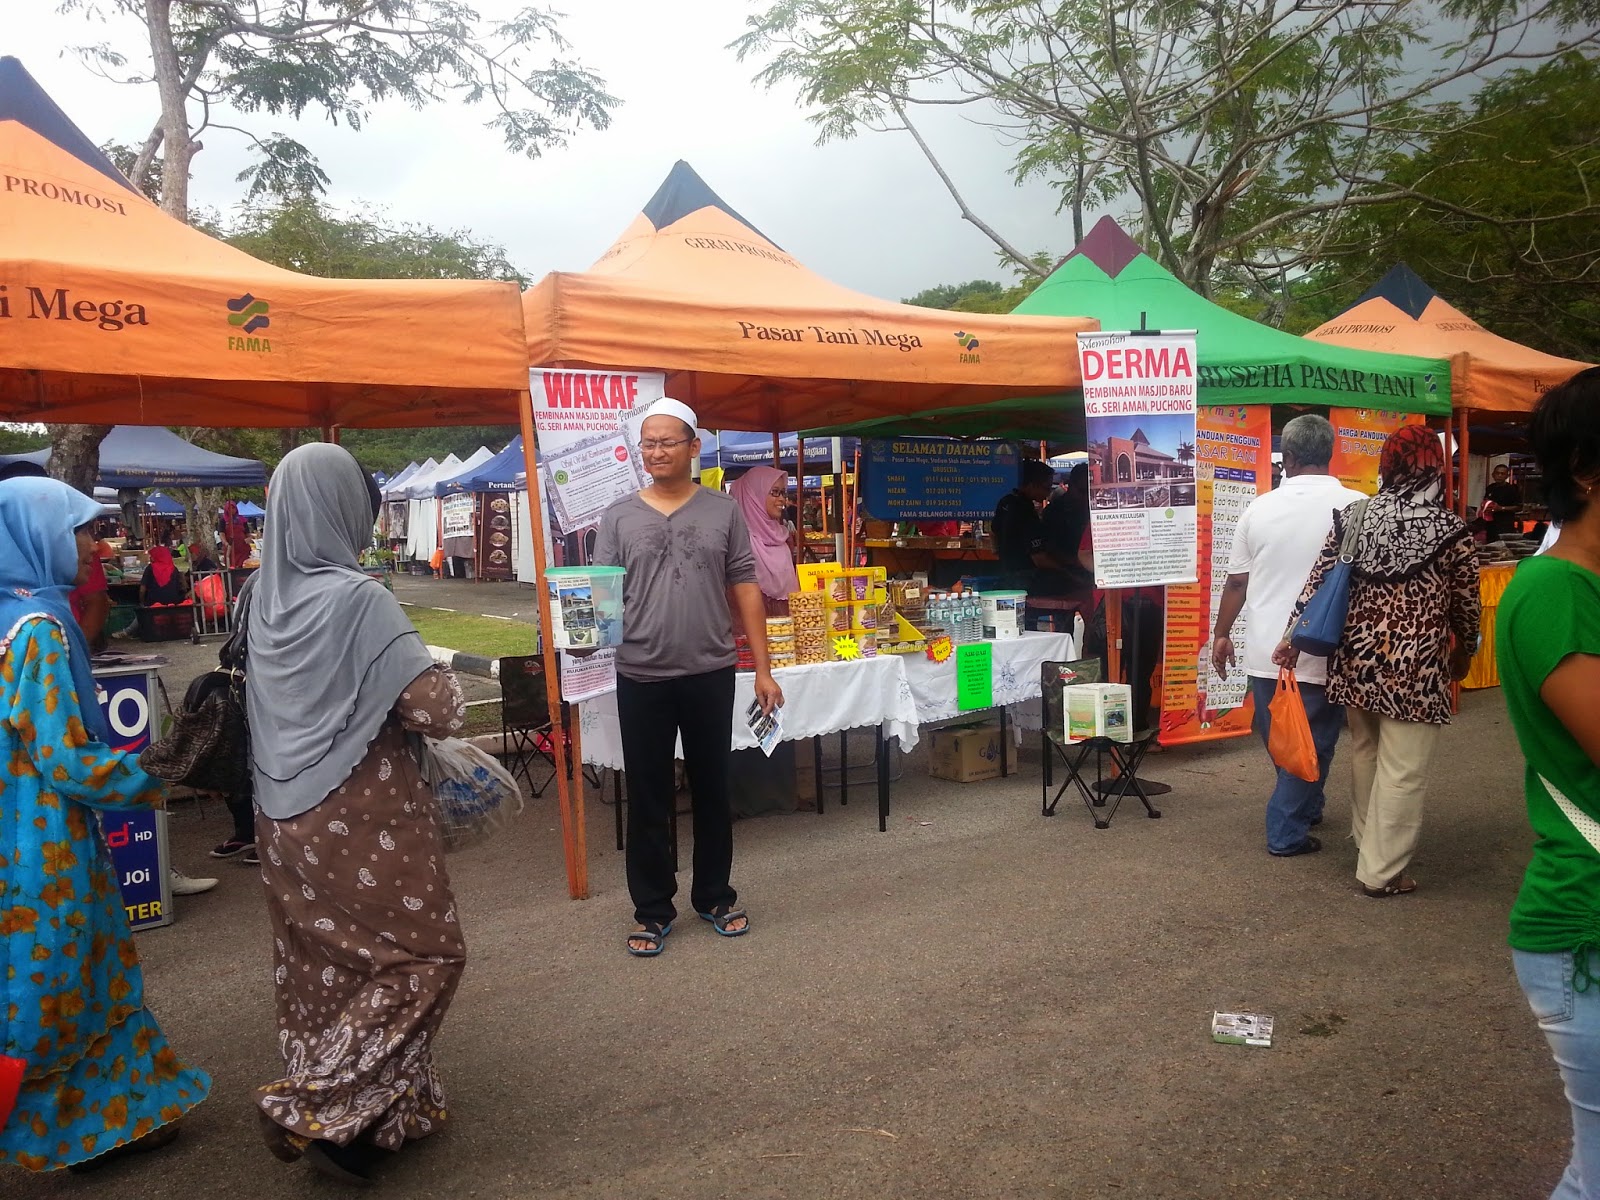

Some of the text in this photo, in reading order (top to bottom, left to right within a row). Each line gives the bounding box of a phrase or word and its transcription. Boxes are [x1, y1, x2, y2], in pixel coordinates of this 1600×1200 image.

[4, 174, 128, 216] PROMOSI
[684, 237, 736, 252] GERAI
[0, 285, 150, 332] i Mega
[737, 320, 923, 352] Pasar Tani Mega
[1315, 324, 1396, 338] GERAI PROMOSI
[228, 336, 272, 353] FAMA
[960, 353, 981, 365] FAMA
[1082, 347, 1193, 381] DERMA
[1197, 364, 1417, 398] RUSETIA PASAR TANI
[543, 371, 639, 410] WAKAF
[1085, 384, 1193, 399] PEMBINAAN MASJID BARU
[1086, 402, 1101, 414] KG.
[1102, 401, 1121, 413] SERI
[1150, 399, 1192, 412] PUCHONG
[535, 411, 618, 421] PEMBINAAN MASJID BARU
[547, 422, 562, 431] SERI
[1338, 427, 1359, 438] HARGA
[1196, 430, 1261, 448] ANDUAN PENGGUNA
[892, 442, 991, 457] SELAMAT DATANG
[1196, 444, 1257, 465] ASAR TANI
[1341, 440, 1383, 457] DI PASA
[488, 481, 516, 489] Pertani
[134, 830, 153, 842] HD
[122, 868, 151, 886] JOi
[125, 900, 163, 922] TER
